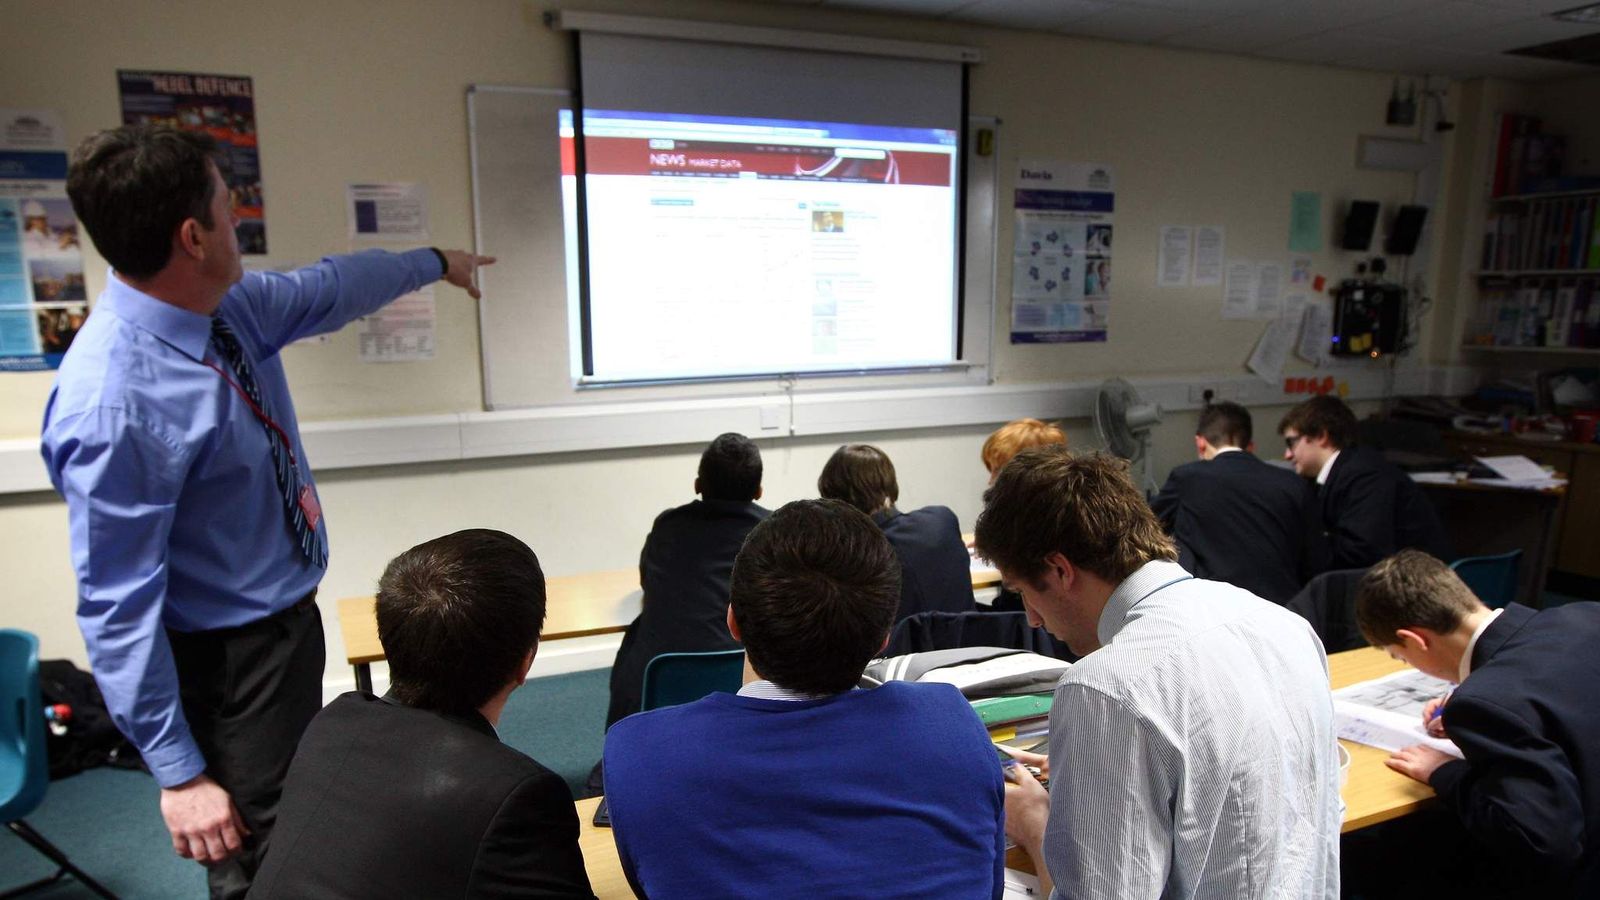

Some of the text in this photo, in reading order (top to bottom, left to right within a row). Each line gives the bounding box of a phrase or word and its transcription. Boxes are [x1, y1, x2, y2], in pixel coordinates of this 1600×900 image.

[195, 77, 252, 97] DEFENCE
[650, 153, 742, 169] NEWS MARKET DATA
